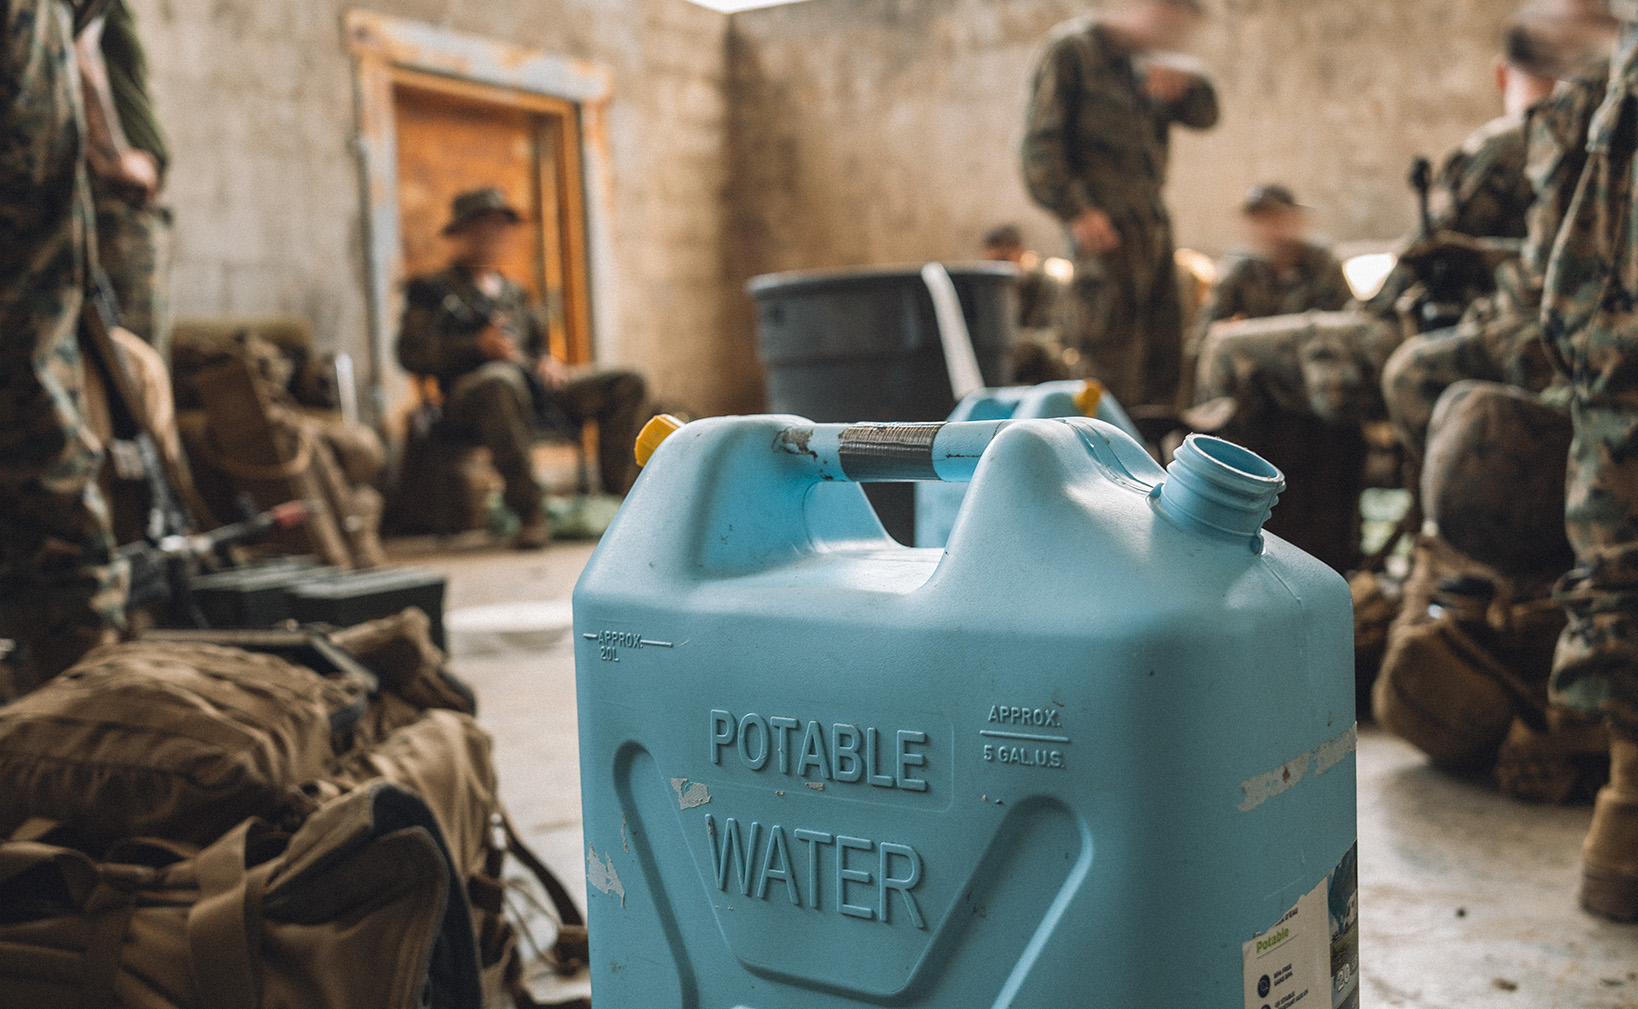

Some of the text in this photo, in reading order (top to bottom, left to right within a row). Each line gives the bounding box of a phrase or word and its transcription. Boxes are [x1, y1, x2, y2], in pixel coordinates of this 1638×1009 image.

[599, 630, 643, 648] APPROX.
[600, 645, 620, 662] 20L
[987, 705, 1062, 727] APPROX.
[710, 709, 928, 791] POTABLE
[983, 744, 993, 761] 5
[705, 813, 925, 929] WATER
[1256, 927, 1289, 953] Potable
